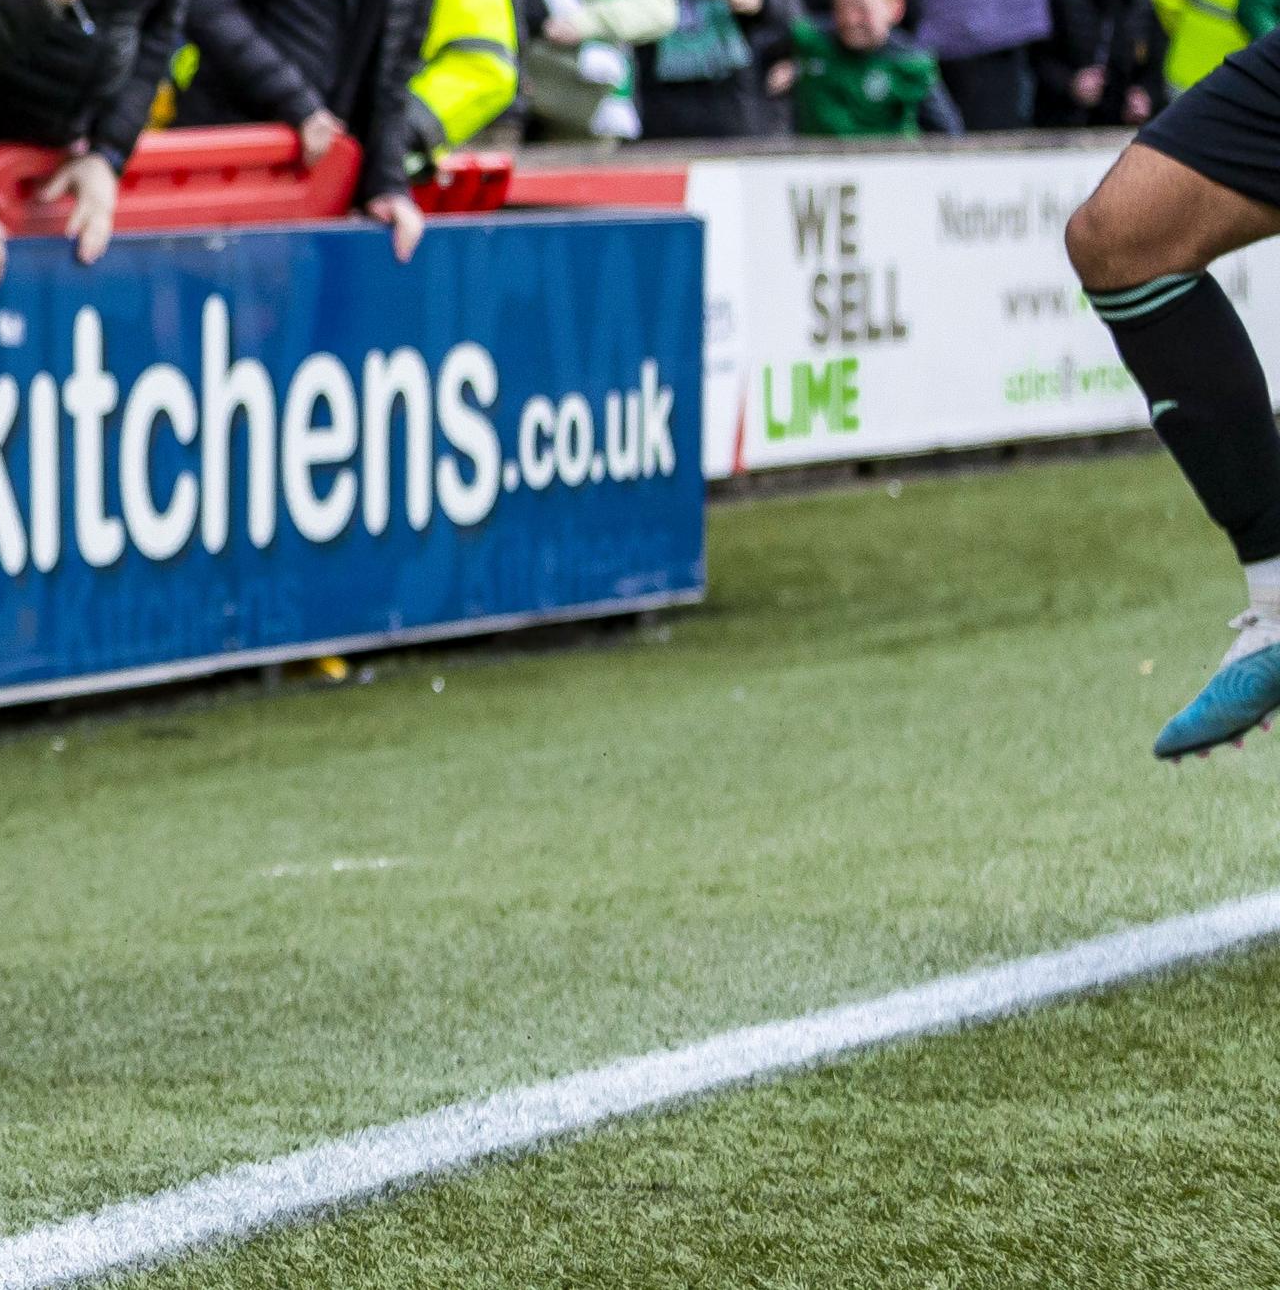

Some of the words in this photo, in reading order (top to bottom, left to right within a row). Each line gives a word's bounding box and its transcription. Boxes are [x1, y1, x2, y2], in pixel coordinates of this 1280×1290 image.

[788, 184, 859, 257] WE
[811, 269, 908, 344] SELL
[762, 357, 861, 441] LIME
